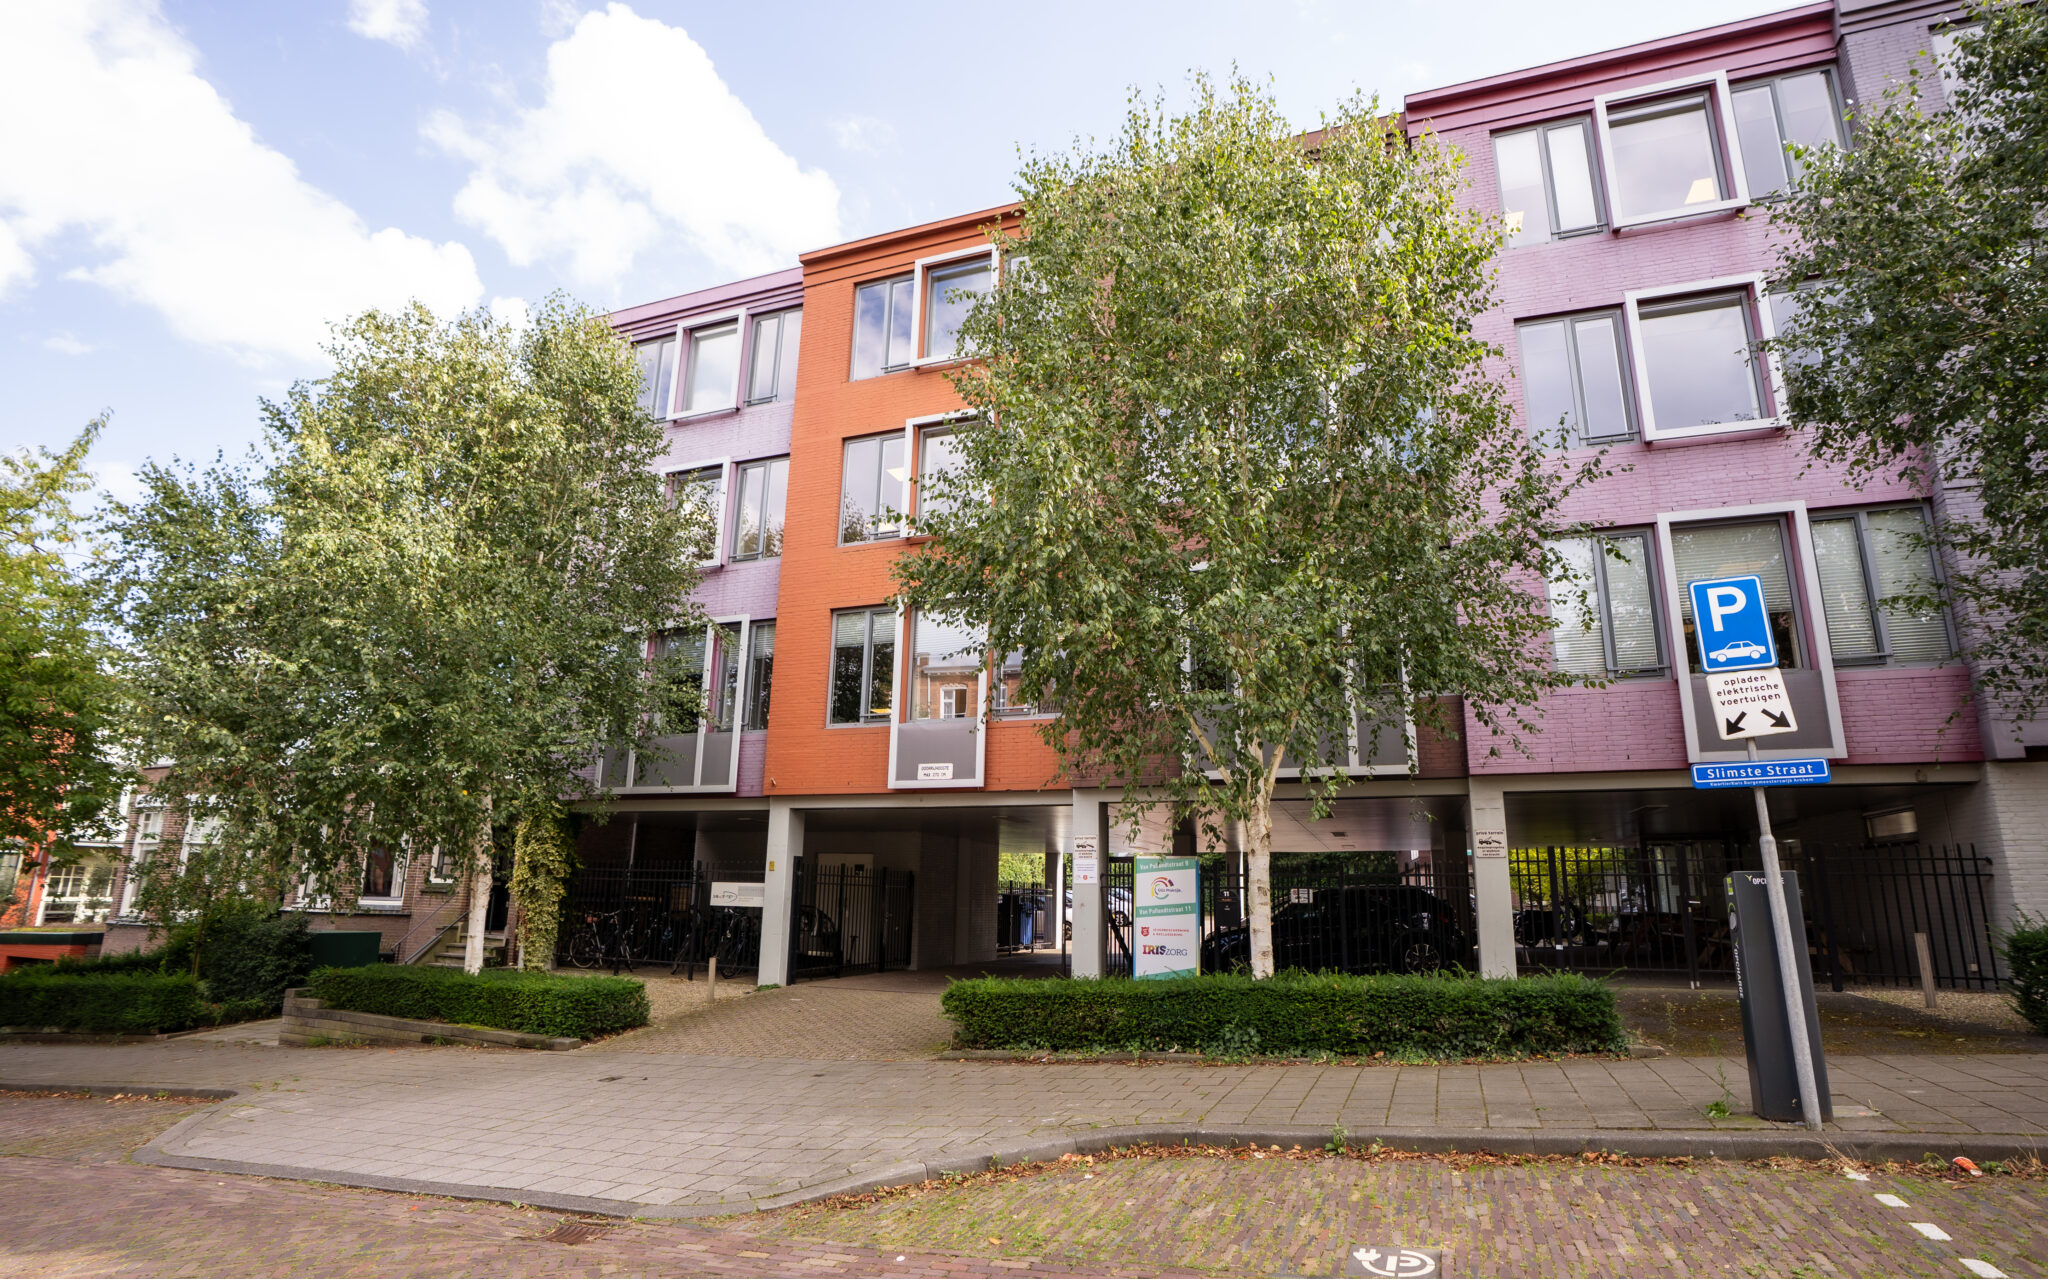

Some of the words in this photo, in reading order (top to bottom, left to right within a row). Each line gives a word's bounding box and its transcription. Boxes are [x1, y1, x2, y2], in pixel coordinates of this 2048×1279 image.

[1706, 586, 1747, 632] P
[1723, 675, 1767, 686] opladen
[1716, 683, 1779, 696] elektrische
[1720, 693, 1781, 706] voertuigen
[1707, 767, 1762, 779] Slimste
[1766, 764, 1814, 776] Straat
[1142, 944, 1188, 956] IRISZORG
[1733, 948, 1744, 999] OPCHARGE
